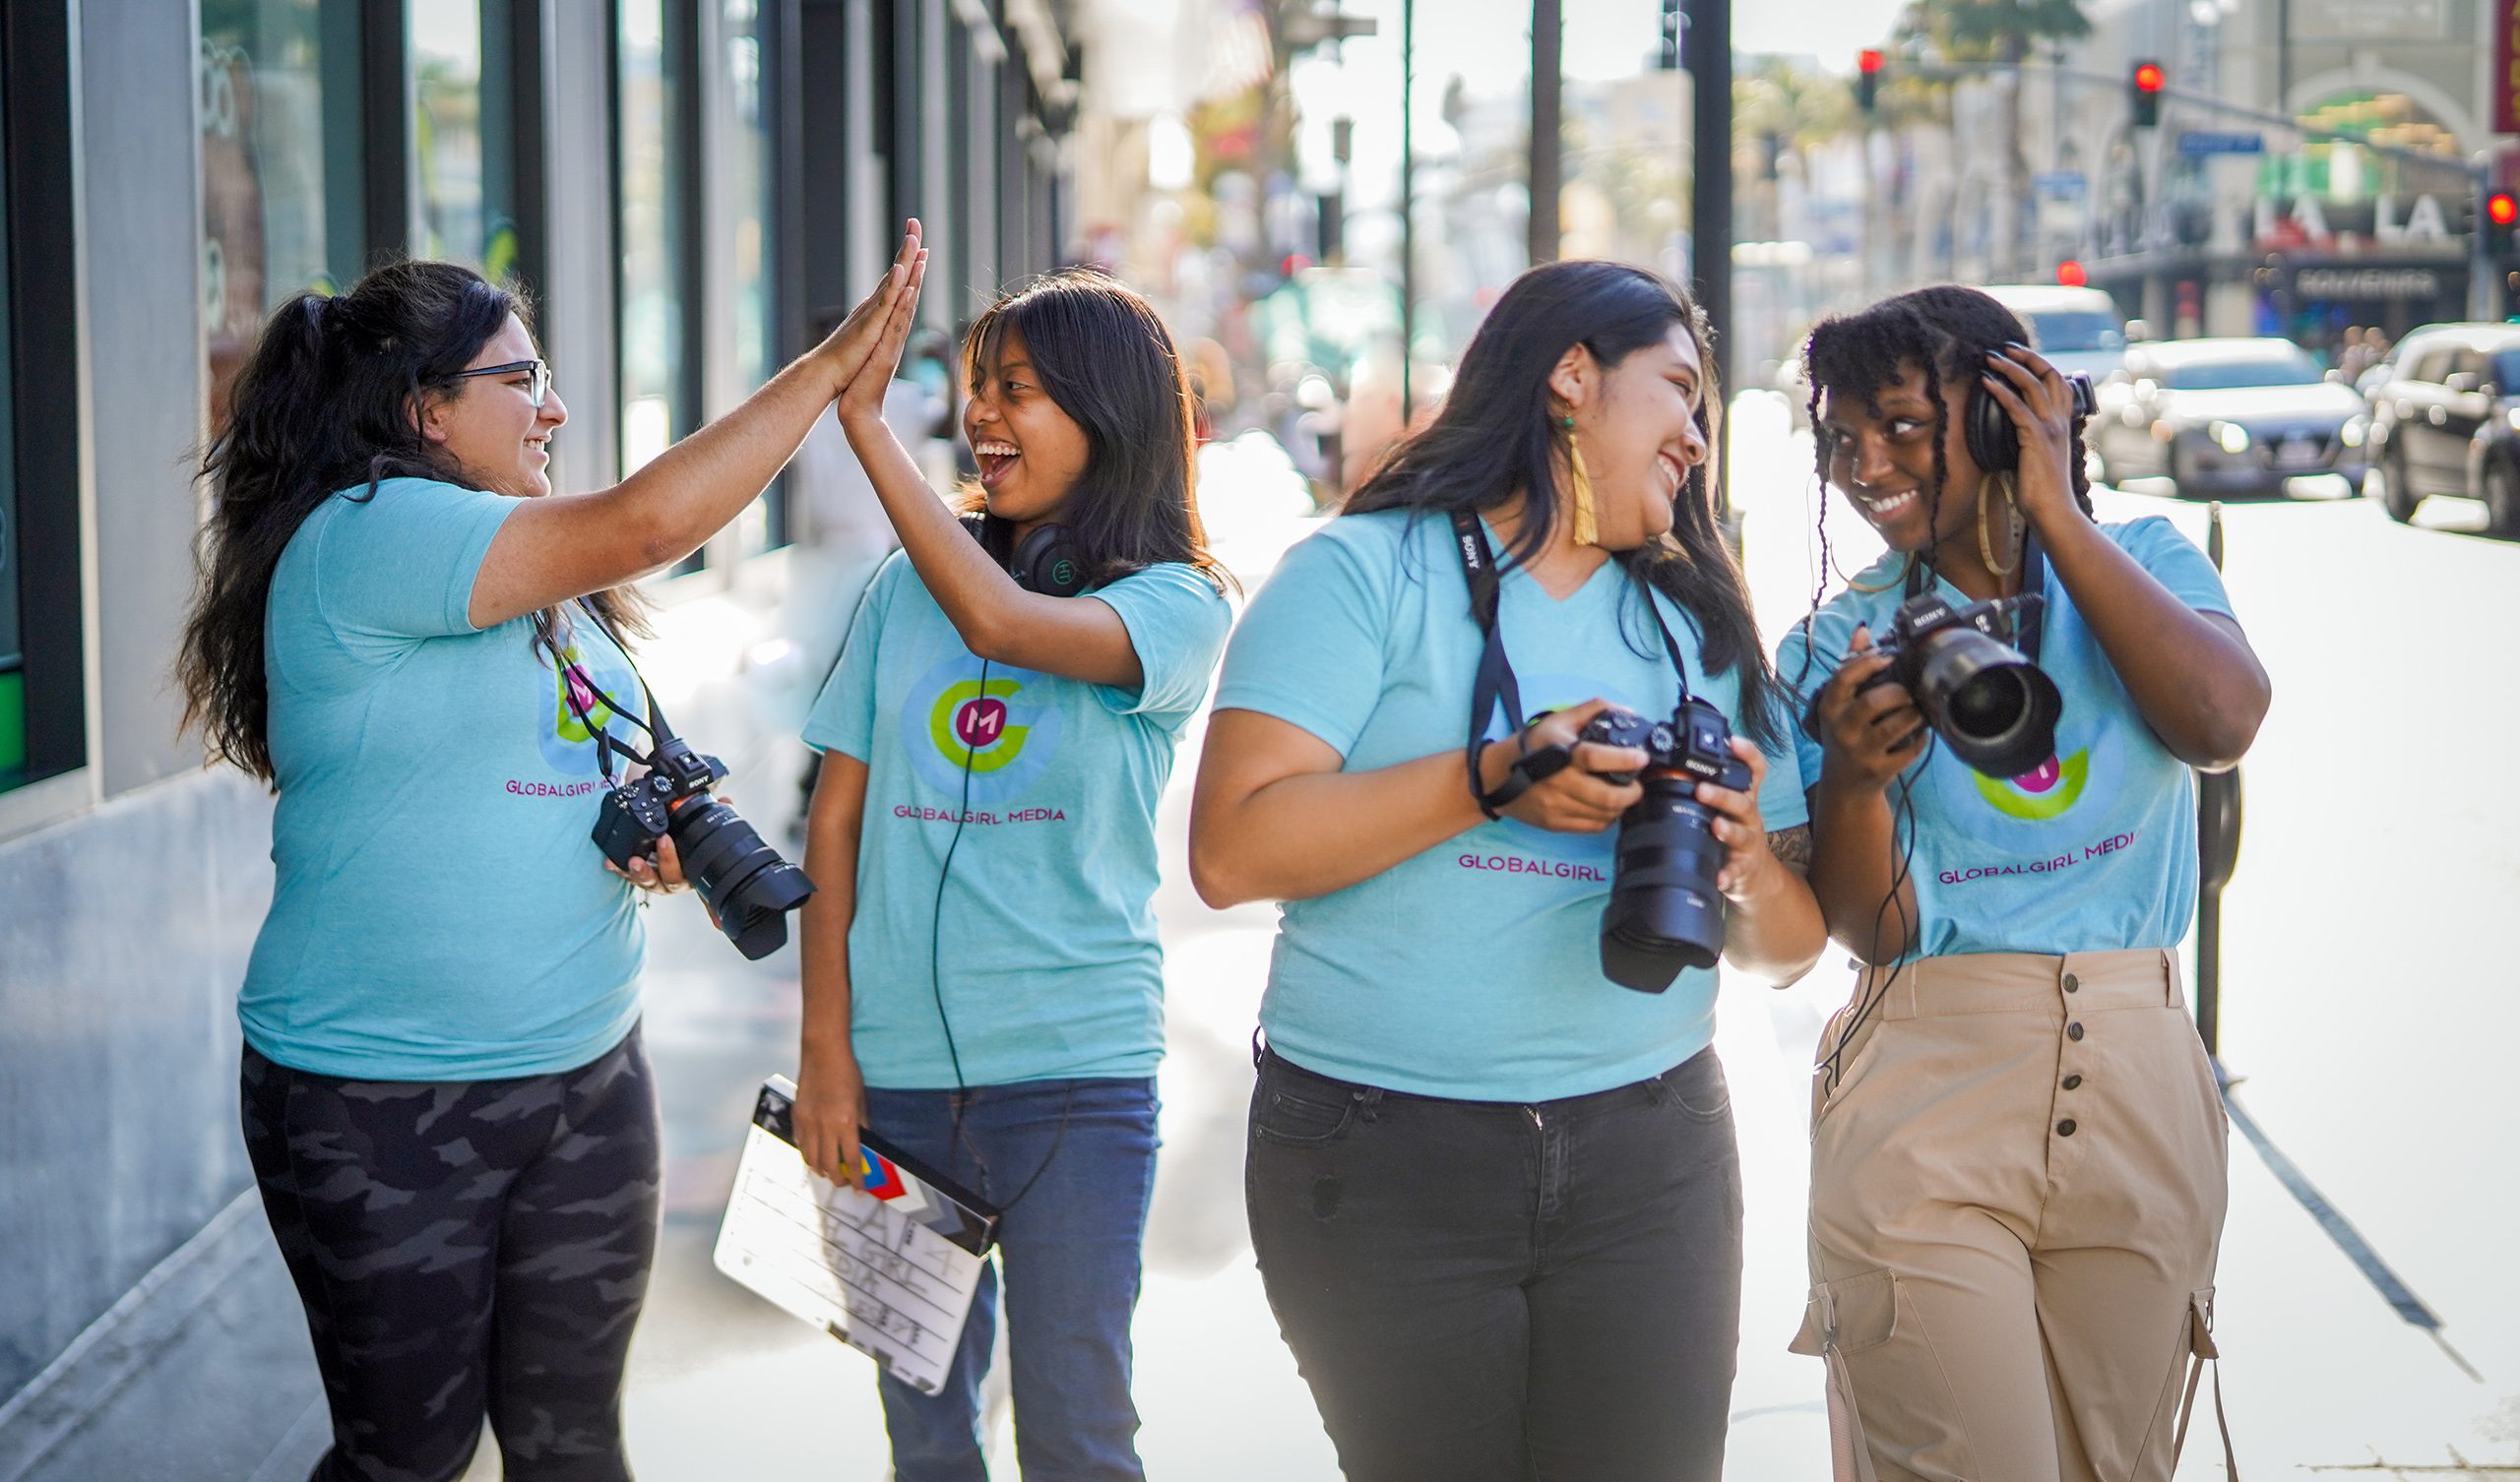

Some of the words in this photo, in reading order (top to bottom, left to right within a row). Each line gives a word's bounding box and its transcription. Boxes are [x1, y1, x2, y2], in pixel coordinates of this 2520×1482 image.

[1462, 535, 1480, 569] SONY
[1913, 606, 1946, 629] SONY
[966, 707, 999, 734] M
[1684, 759, 1719, 776] SONY
[688, 774, 709, 789] SONY
[894, 805, 1002, 825] GLOBALGIRL
[1008, 808, 1065, 824] MEDIA
[1458, 853, 1606, 882] GLOBALGIRL
[1938, 853, 2078, 885] GLOBALGIRL
[2084, 830, 2139, 859] MEDI
